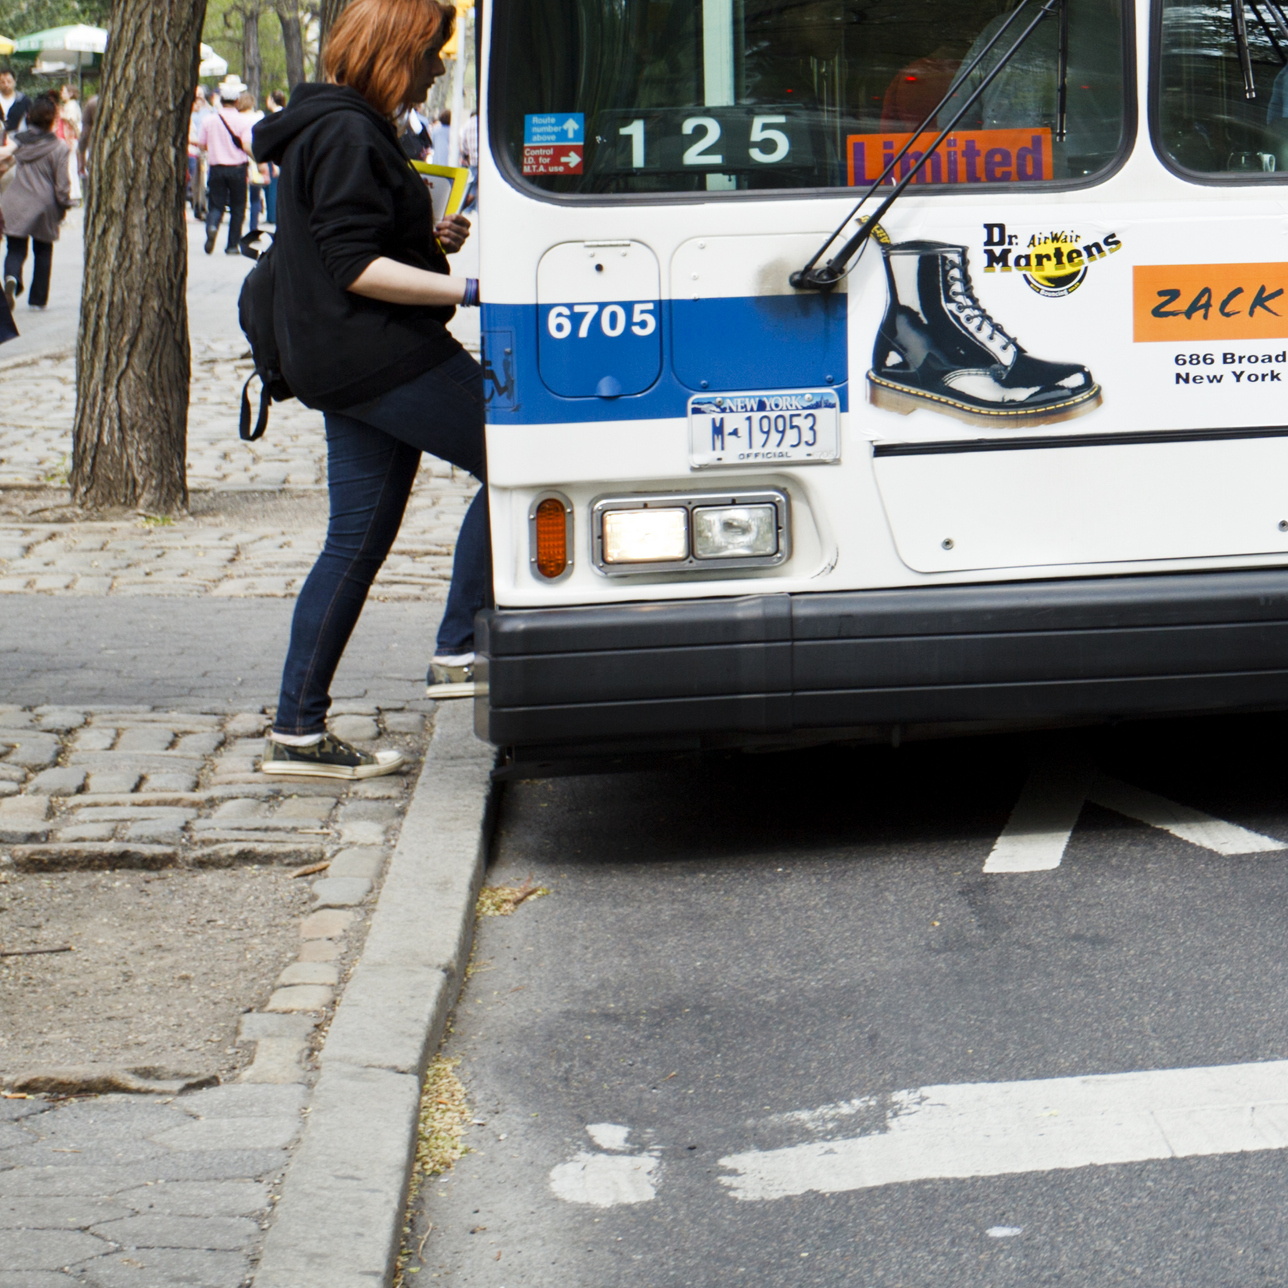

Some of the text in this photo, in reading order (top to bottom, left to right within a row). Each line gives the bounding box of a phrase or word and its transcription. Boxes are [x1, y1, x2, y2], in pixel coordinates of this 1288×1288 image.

[532, 116, 556, 125] Route
[532, 124, 562, 133] number
[531, 133, 557, 142] above
[524, 147, 554, 156] Control
[538, 156, 551, 164] for
[853, 134, 1045, 187] Limited
[548, 165, 565, 173] use
[983, 222, 1019, 247] Dr.
[1027, 229, 1082, 249] AirWair
[982, 232, 1123, 273] Martens
[546, 301, 658, 339] 6705
[1174, 351, 1216, 367] 686
[1174, 369, 1225, 386] New
[1231, 368, 1283, 384] York
[725, 394, 803, 413] NEW YORK
[738, 451, 792, 461] OFFICIAL
